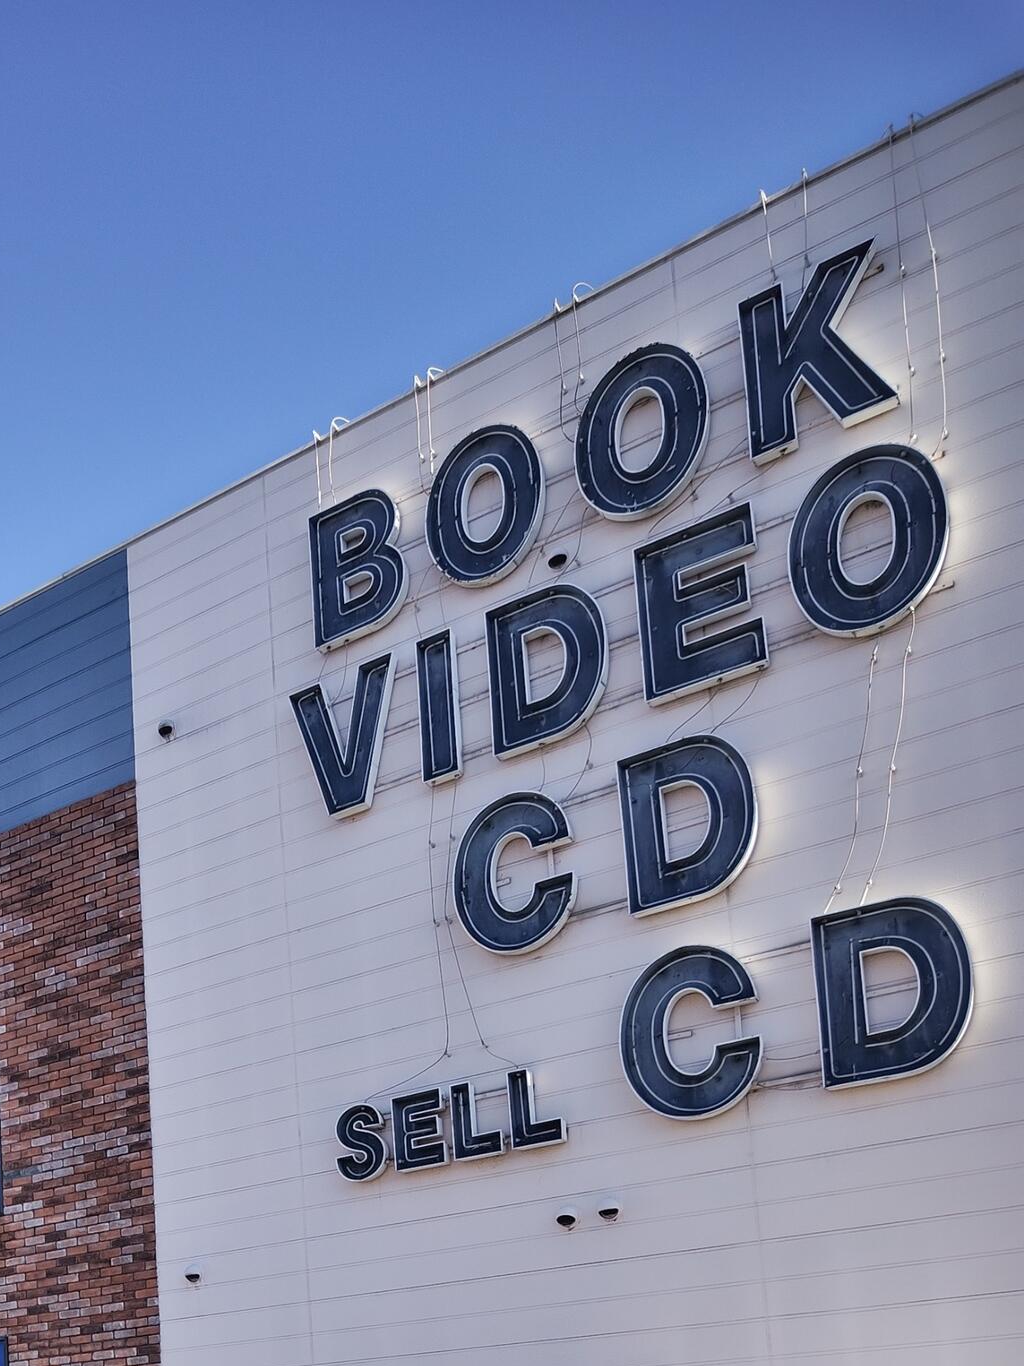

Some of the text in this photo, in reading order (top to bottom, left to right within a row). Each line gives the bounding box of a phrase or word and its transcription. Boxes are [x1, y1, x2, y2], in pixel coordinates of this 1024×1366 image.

[307, 237, 900, 653] BOOK
[288, 443, 953, 818] VIDEO
[452, 734, 760, 956] CD
[618, 895, 976, 1122] CD
[334, 1067, 568, 1183] SELL
